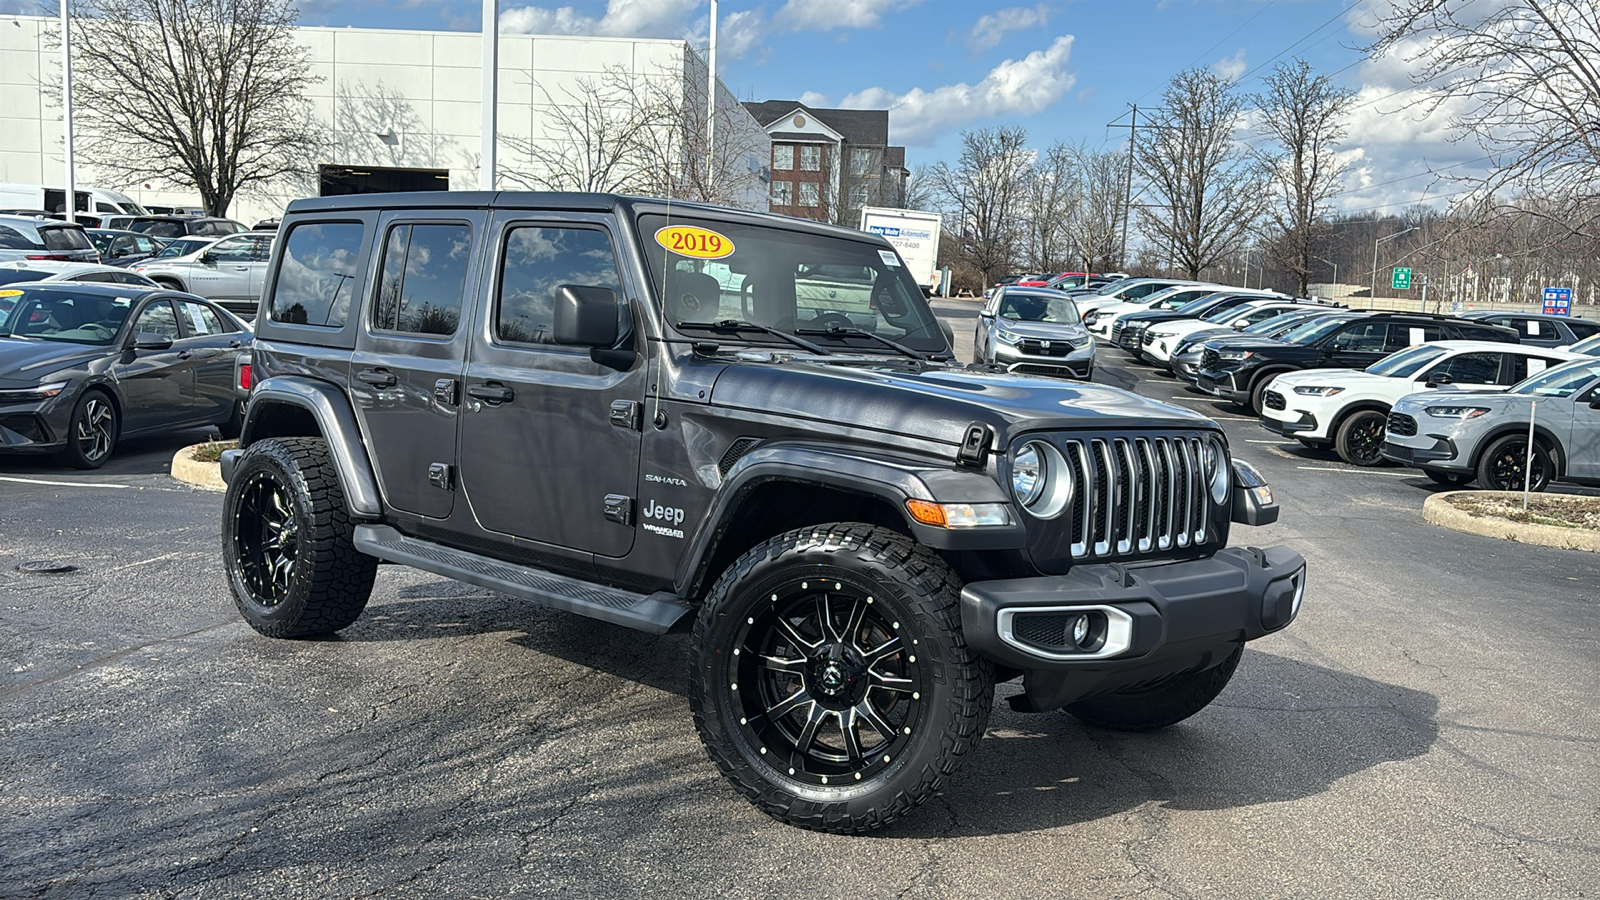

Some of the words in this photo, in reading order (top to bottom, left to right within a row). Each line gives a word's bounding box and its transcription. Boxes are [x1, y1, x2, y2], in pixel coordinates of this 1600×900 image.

[870, 227, 884, 236] Andy
[885, 228, 899, 236] Mohr
[900, 230, 930, 238] Automotive
[671, 232, 722, 253] 2019
[645, 474, 688, 487] SAHARA
[643, 499, 685, 526] Jeep
[643, 523, 684, 537] WRANGLER
